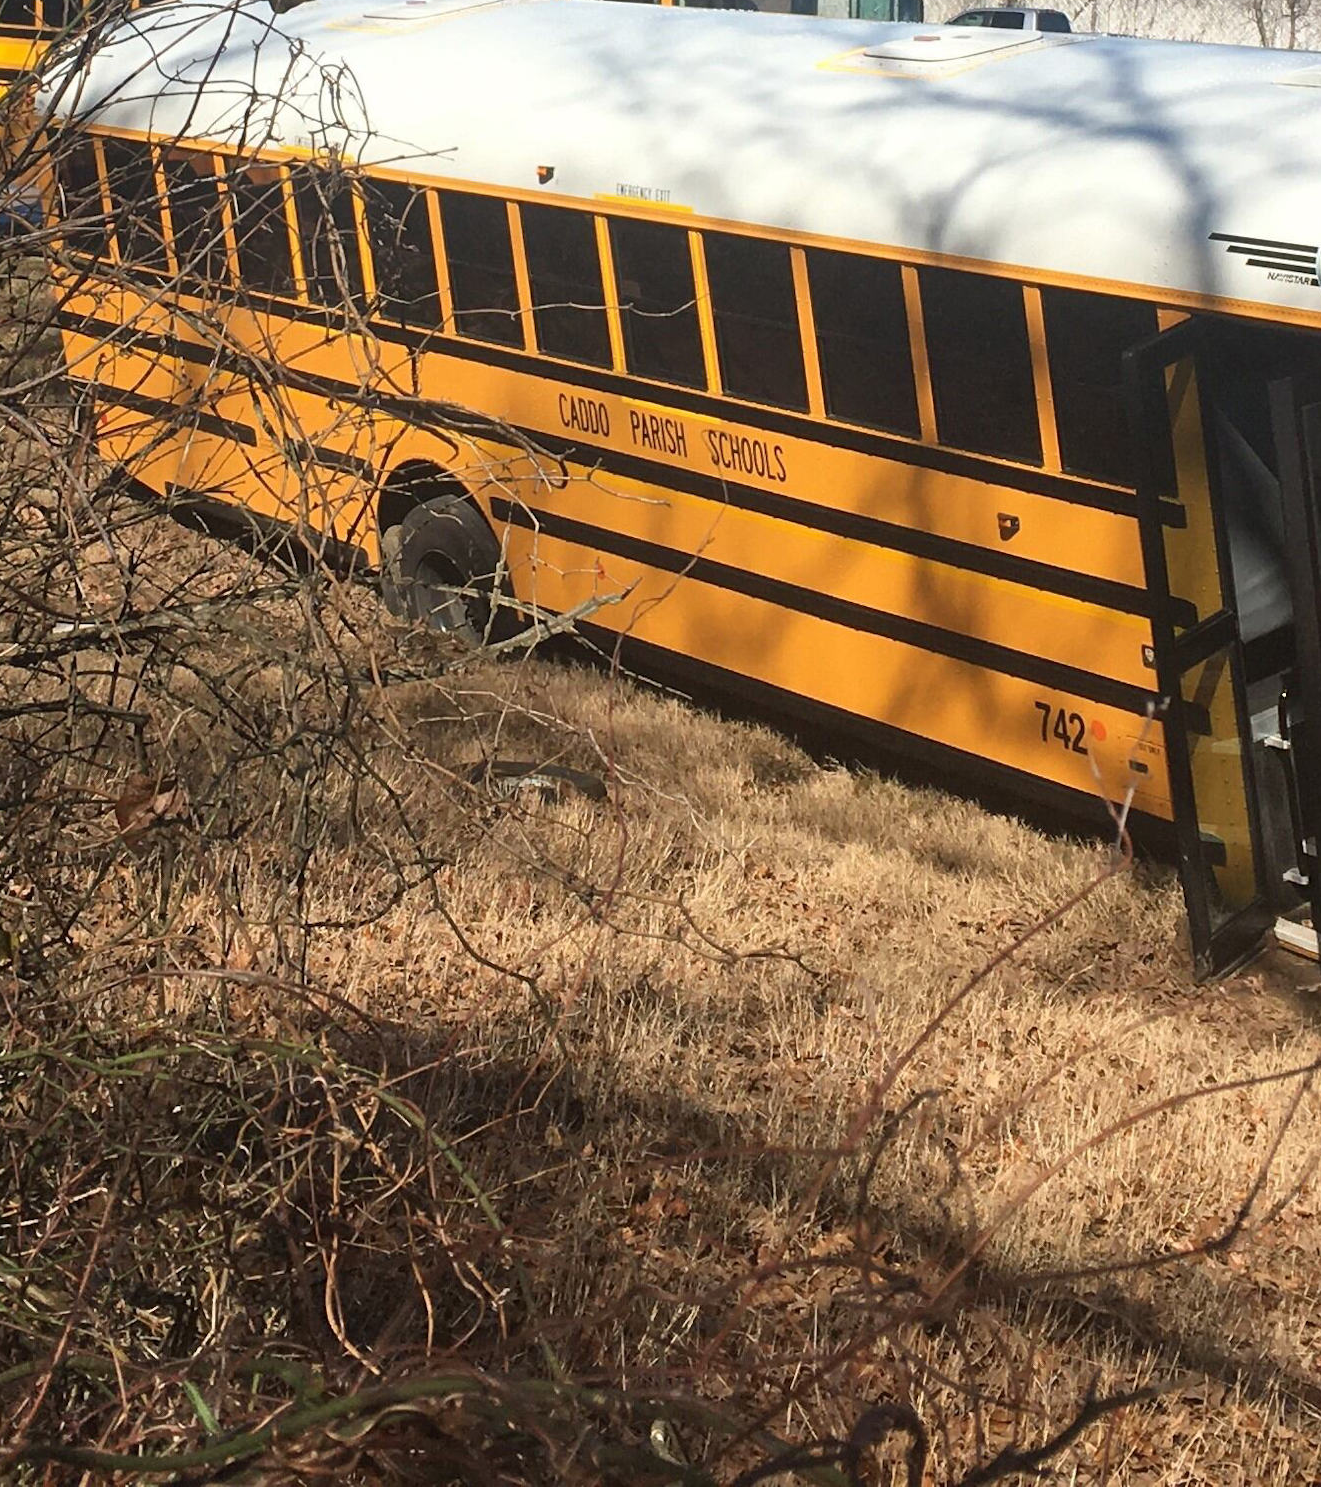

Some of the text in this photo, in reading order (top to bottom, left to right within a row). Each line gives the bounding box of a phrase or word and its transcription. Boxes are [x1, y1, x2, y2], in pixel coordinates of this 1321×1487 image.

[655, 188, 671, 203] EXIT
[558, 393, 786, 482] CADDO PARISH SCHOOLS
[1035, 700, 1088, 755] 742
